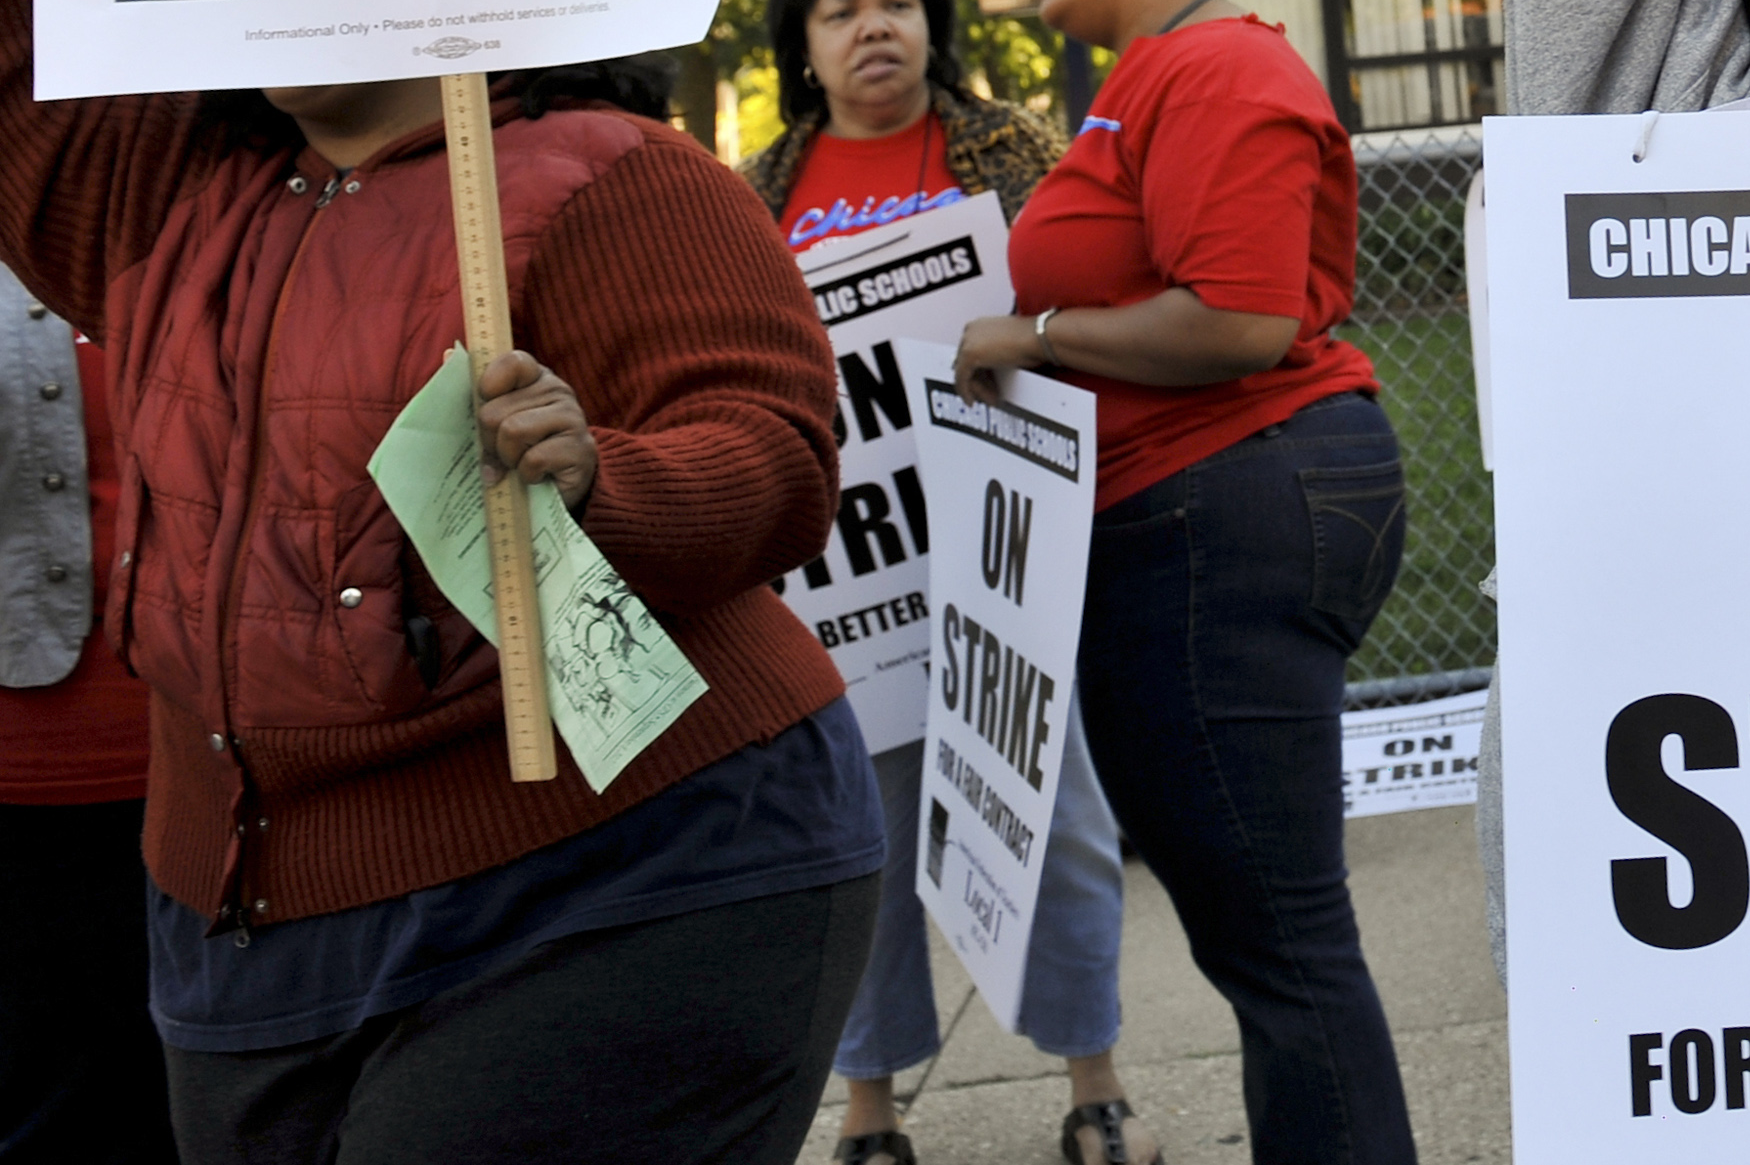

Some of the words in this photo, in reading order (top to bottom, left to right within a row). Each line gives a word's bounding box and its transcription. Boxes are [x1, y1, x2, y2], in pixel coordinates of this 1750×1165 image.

[245, 23, 335, 42] Informational
[339, 21, 370, 37] Only
[382, 18, 425, 32] Please
[428, 16, 443, 28] do
[446, 14, 465, 26] not
[858, 247, 973, 308] SCHOOLS
[834, 340, 912, 450] N
[981, 478, 1033, 608] ON
[815, 590, 929, 649] BETTER
[942, 602, 1055, 794] STRIKE
[1383, 734, 1453, 757] ON
